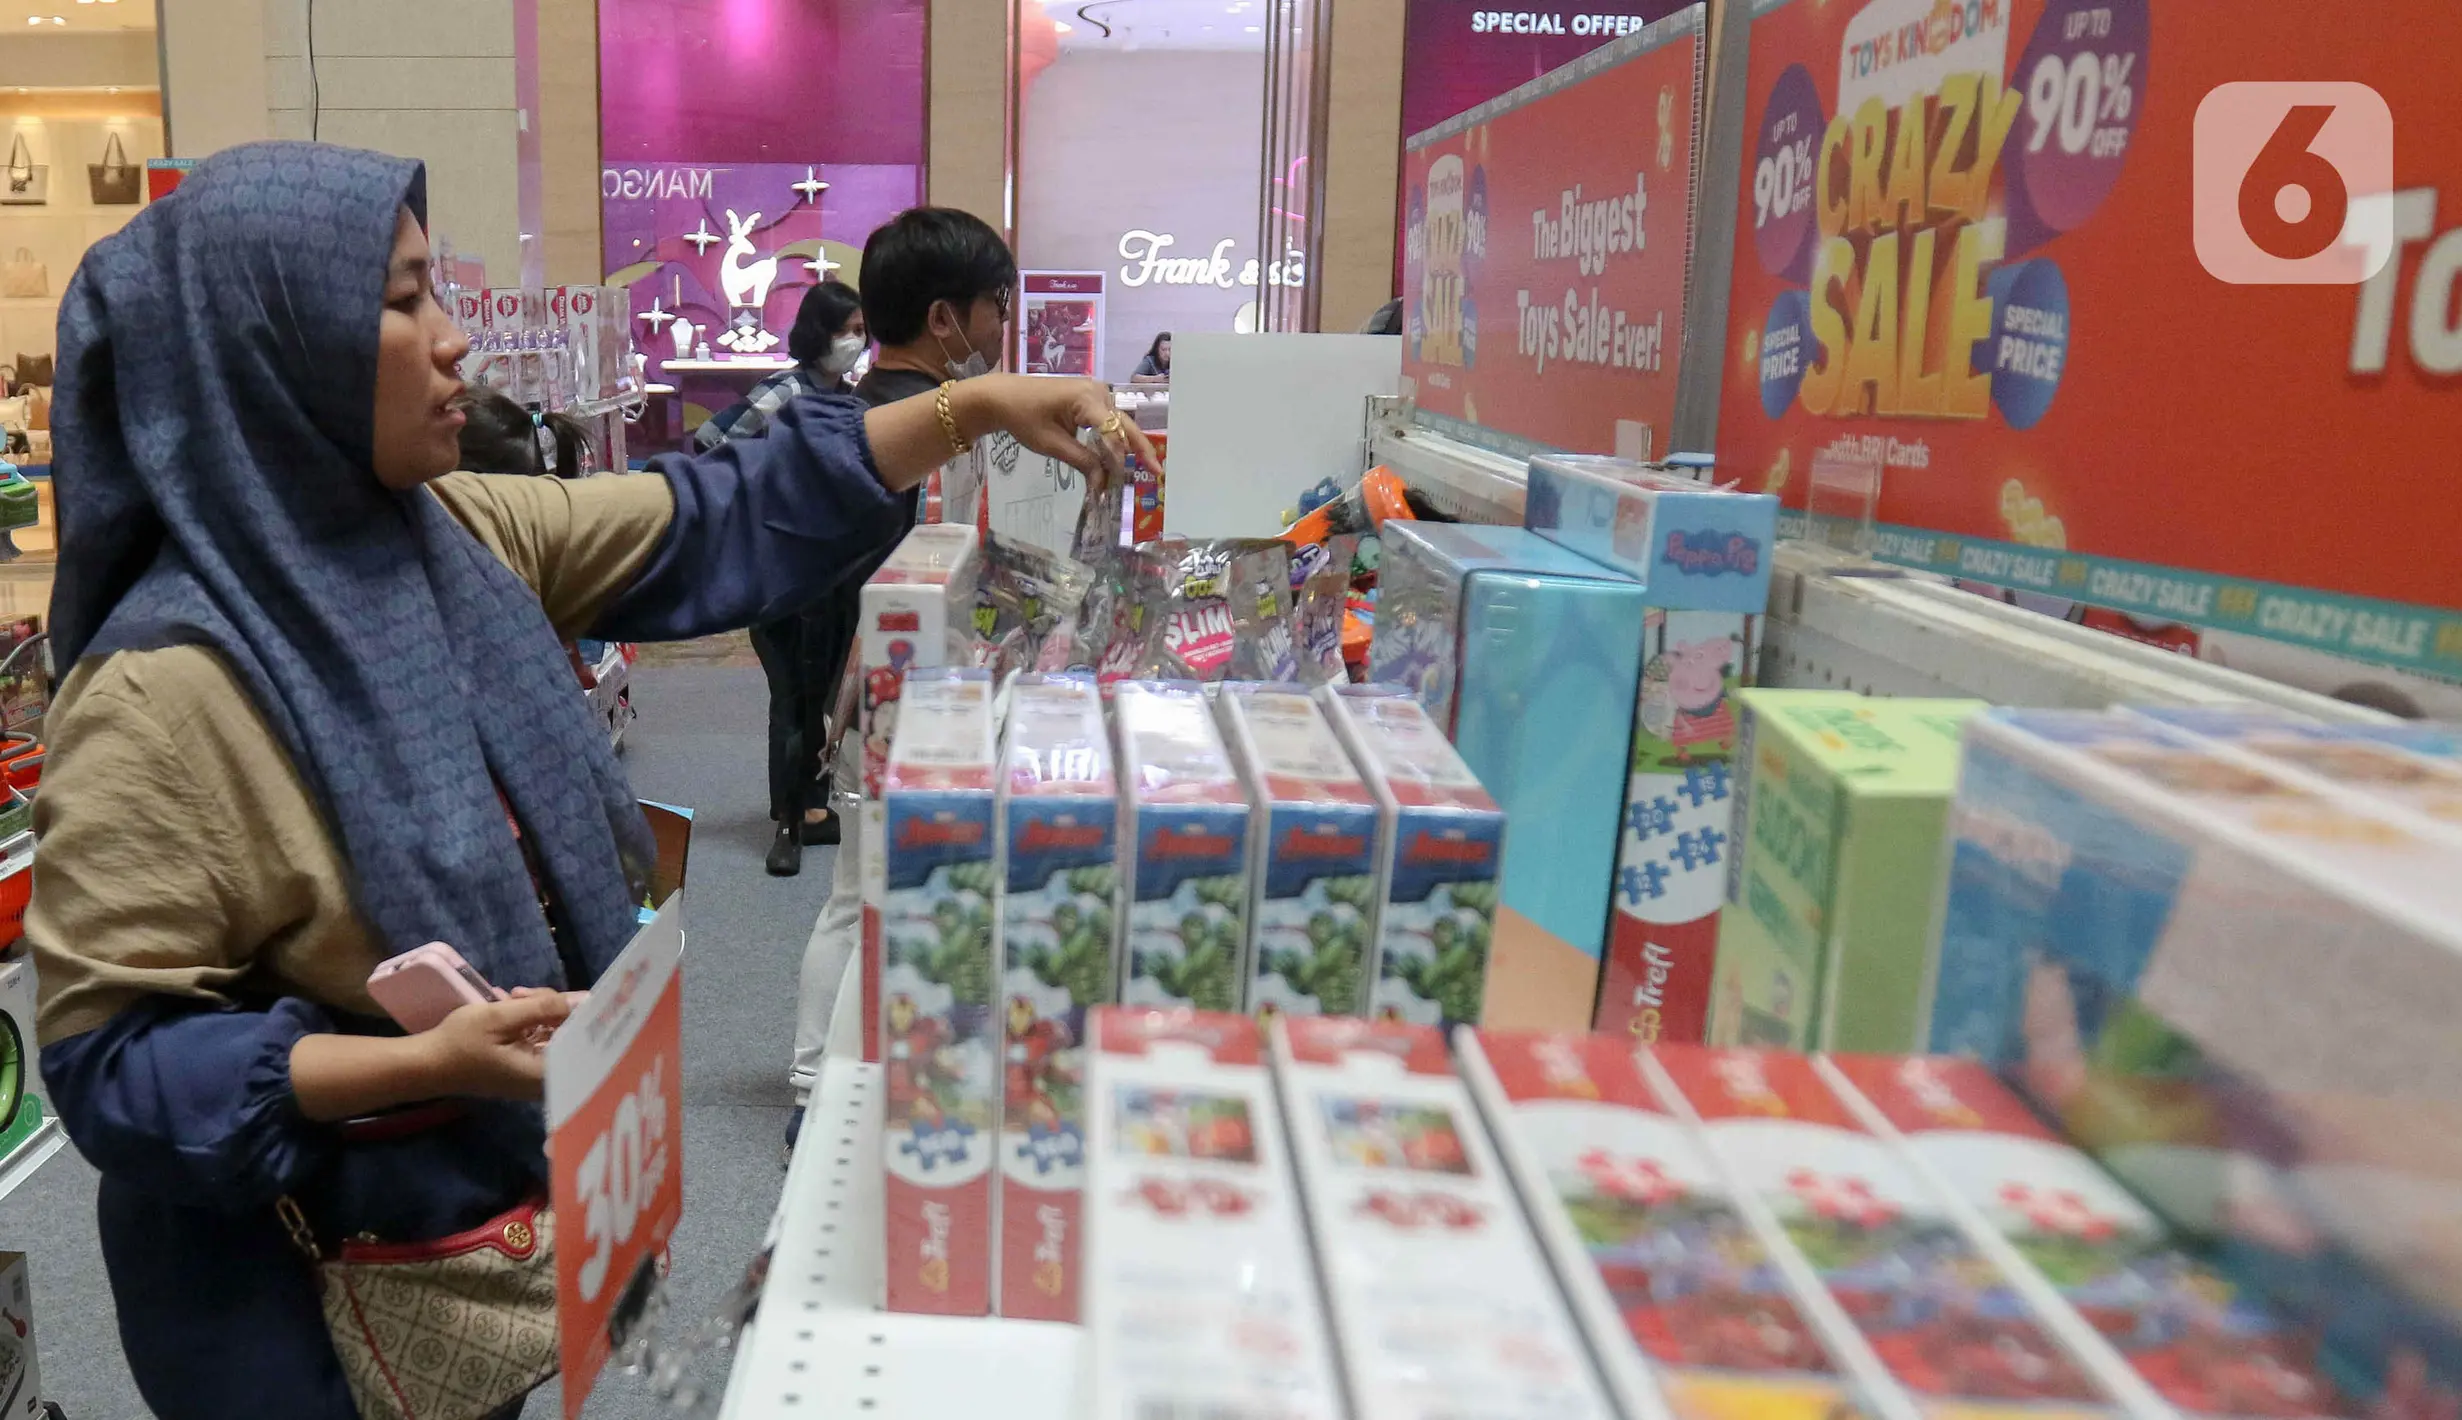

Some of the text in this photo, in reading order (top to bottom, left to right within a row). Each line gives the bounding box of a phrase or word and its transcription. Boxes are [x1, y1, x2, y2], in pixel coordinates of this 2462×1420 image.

[1471, 11, 1565, 35] SPECIAL
[1571, 14, 1644, 37] OFFER
[2064, 8, 2112, 40] UP TO
[1850, 33, 1892, 80] TOYS
[2029, 51, 2136, 155] 90%
[1772, 112, 1798, 143] UP TO
[2091, 127, 2128, 157] OFF
[1816, 71, 2023, 237] CRAZY
[1754, 134, 1812, 230] 90%
[1793, 186, 1812, 213] OFF
[1533, 172, 1647, 276] The Biggest
[1118, 229, 1235, 289] Frank
[1238, 258, 1260, 286] &
[1517, 289, 1559, 374] Toys
[1563, 287, 1611, 365] Sale
[1613, 310, 1663, 371] Ever!
[1764, 324, 1800, 352] SPECIAL
[1801, 217, 2007, 420] SALE
[2003, 303, 2066, 340] SPECIAL
[1763, 348, 1800, 381] PRICE
[1996, 335, 2062, 382] PRICE
[1887, 436, 1929, 468] Cards
[1961, 545, 2055, 588] CRAZY SALE
[2091, 567, 2214, 617] CRAZY SALE
[2259, 593, 2430, 658] CRAZY SALE
[1633, 942, 1675, 1007] Trefl
